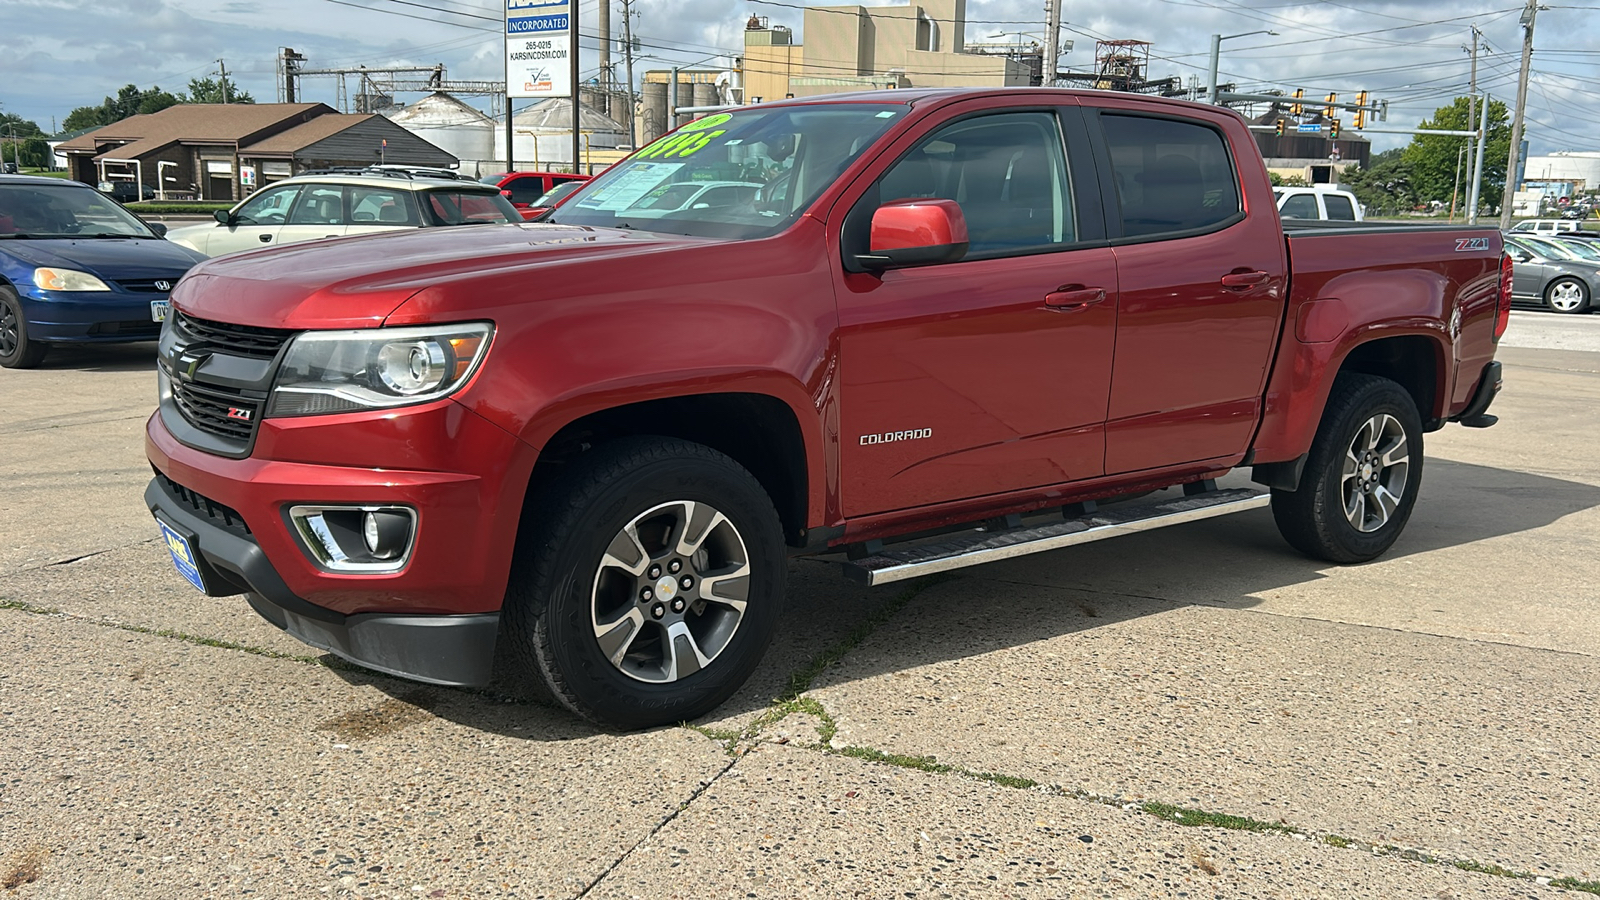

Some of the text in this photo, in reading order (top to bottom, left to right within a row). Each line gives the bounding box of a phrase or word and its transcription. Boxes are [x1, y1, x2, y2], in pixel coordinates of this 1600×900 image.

[509, 18, 567, 31] INCORPORATED
[526, 41, 551, 50] 265-0215
[1455, 237, 1489, 252] Z71
[228, 407, 251, 420] Z71
[860, 427, 932, 446] COLORADO
